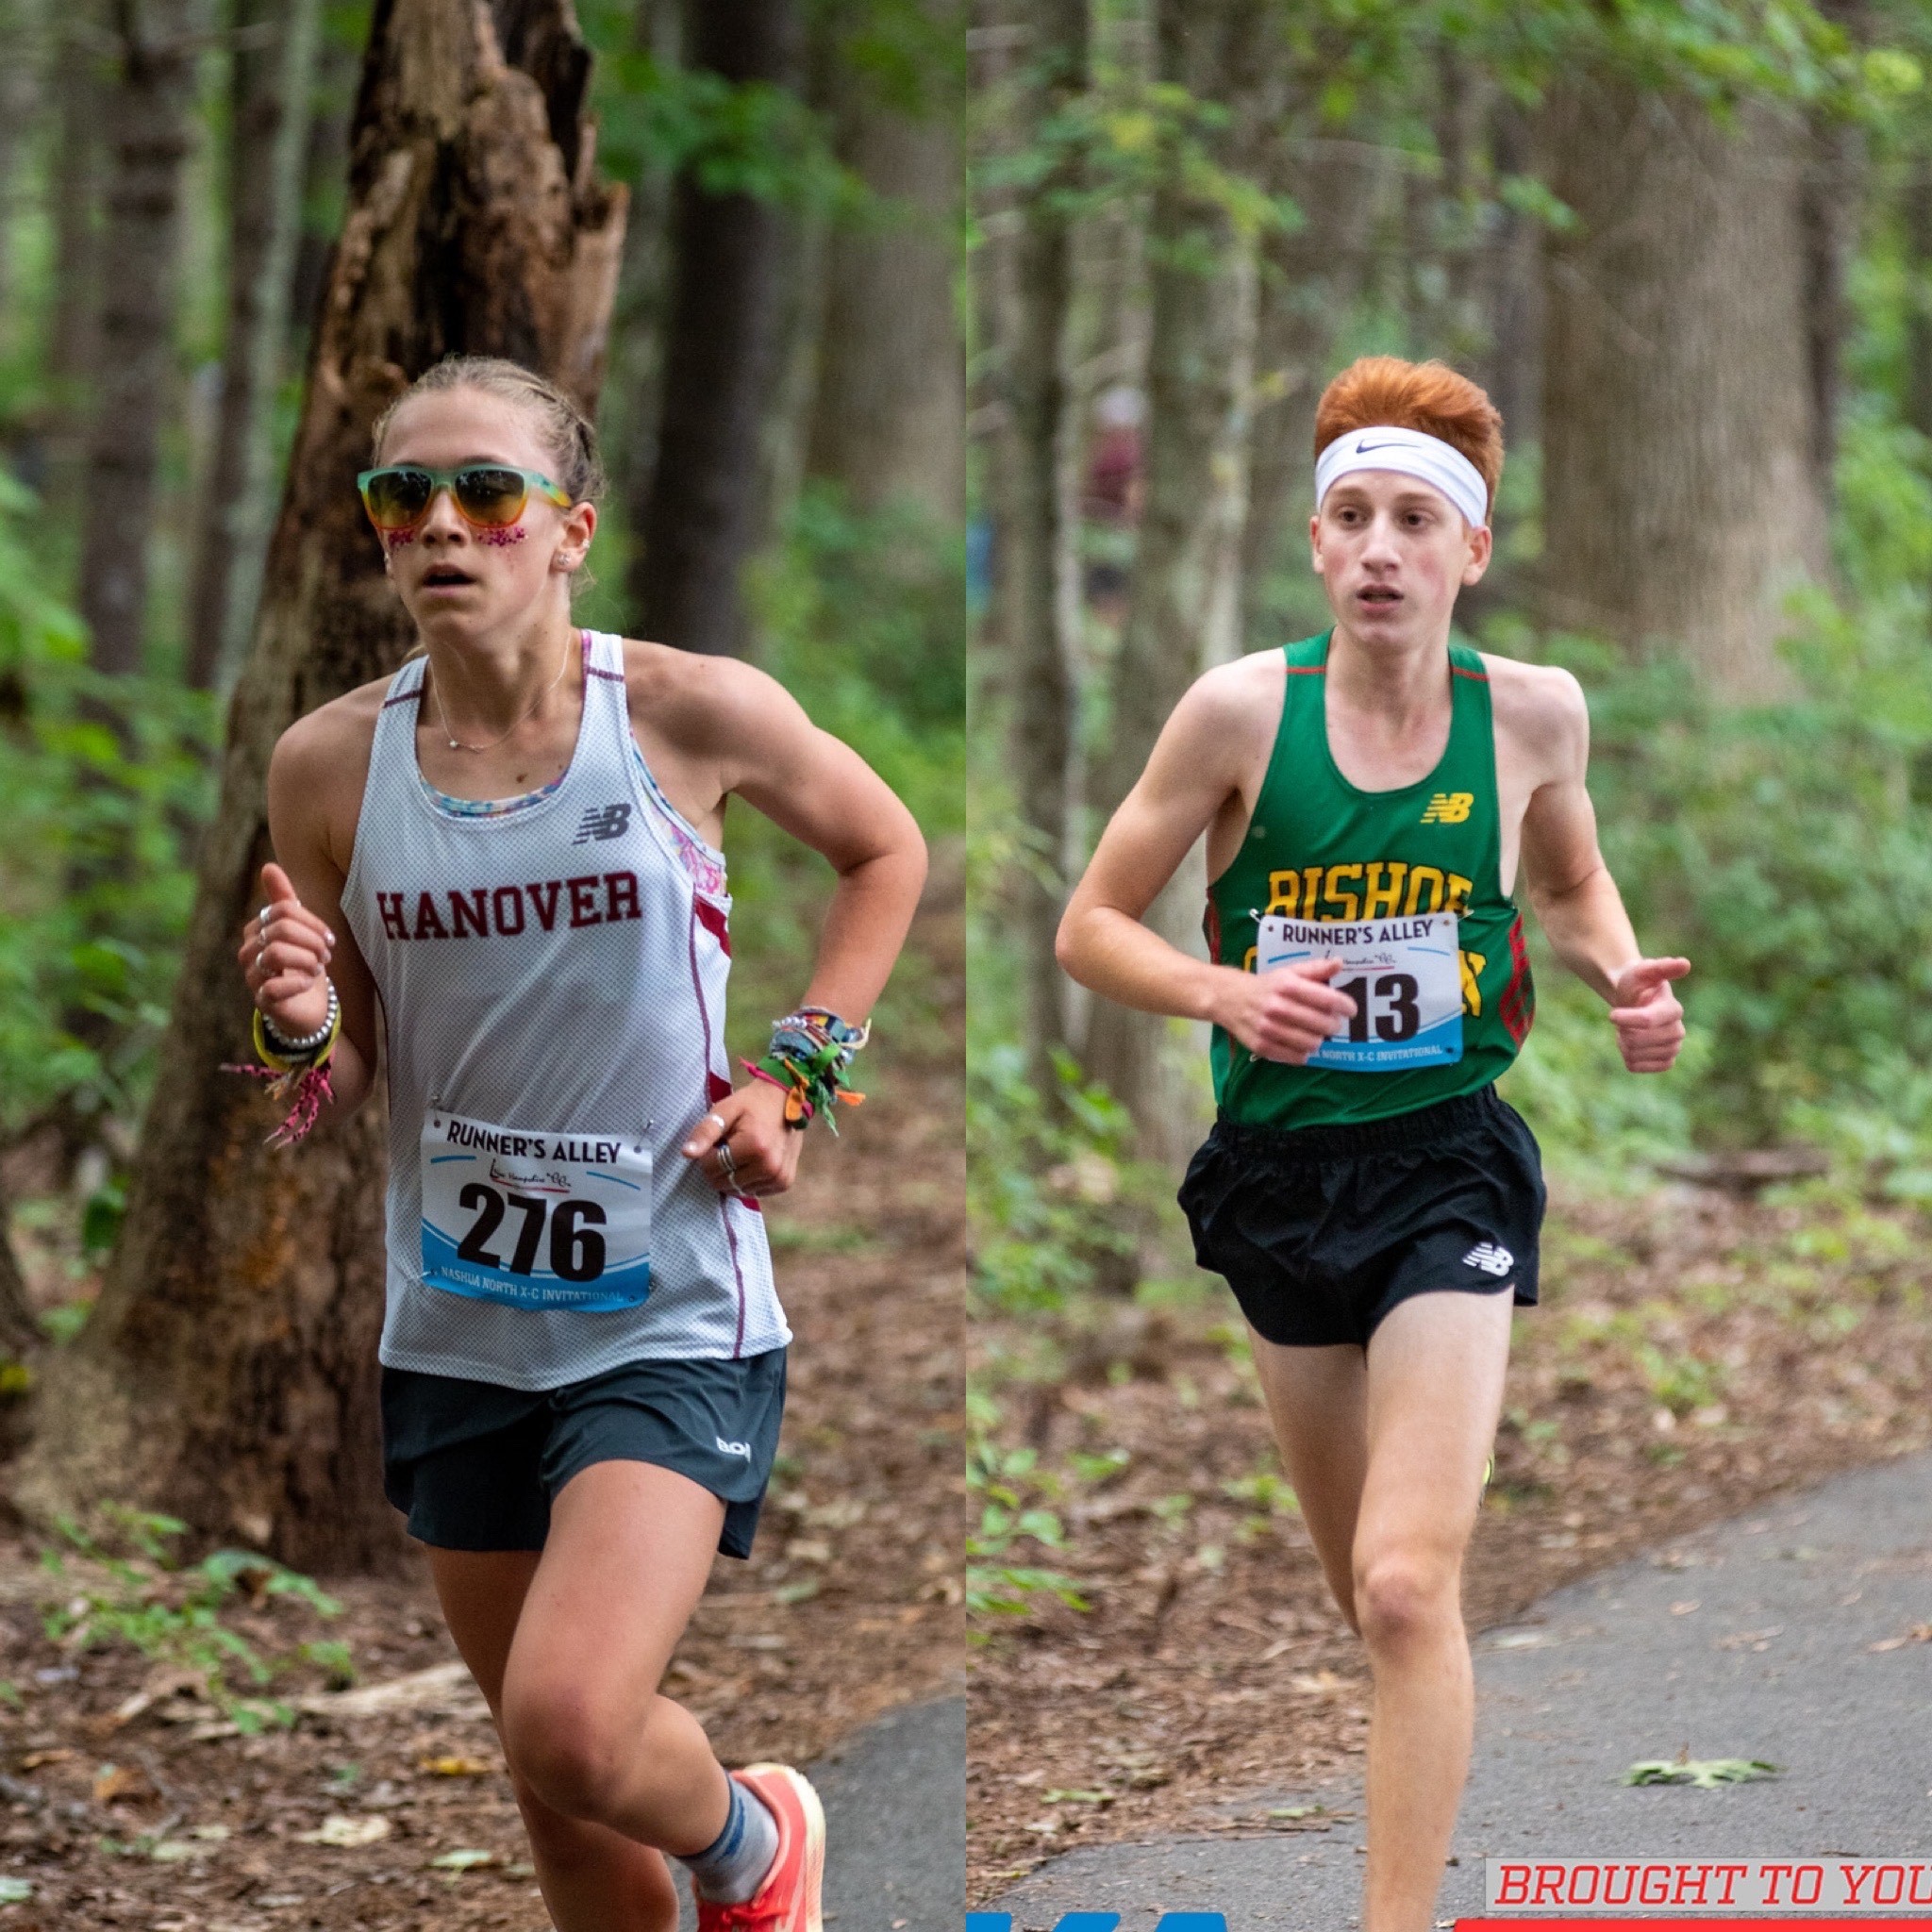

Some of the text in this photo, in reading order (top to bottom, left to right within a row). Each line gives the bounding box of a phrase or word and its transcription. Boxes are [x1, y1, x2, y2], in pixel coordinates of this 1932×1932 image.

[376, 870, 643, 941] HANOVER
[1282, 919, 1434, 945] RUNNER'S ALLEY
[1324, 973, 1421, 1043] 13
[1322, 1044, 1442, 1061] NORTH X-C INVITATIONAL
[447, 1120, 622, 1164] RUNNER'S ALLEY
[457, 1182, 608, 1283] 276
[441, 1266, 624, 1303] NASHUA NORTH X-C INVITATIONAL
